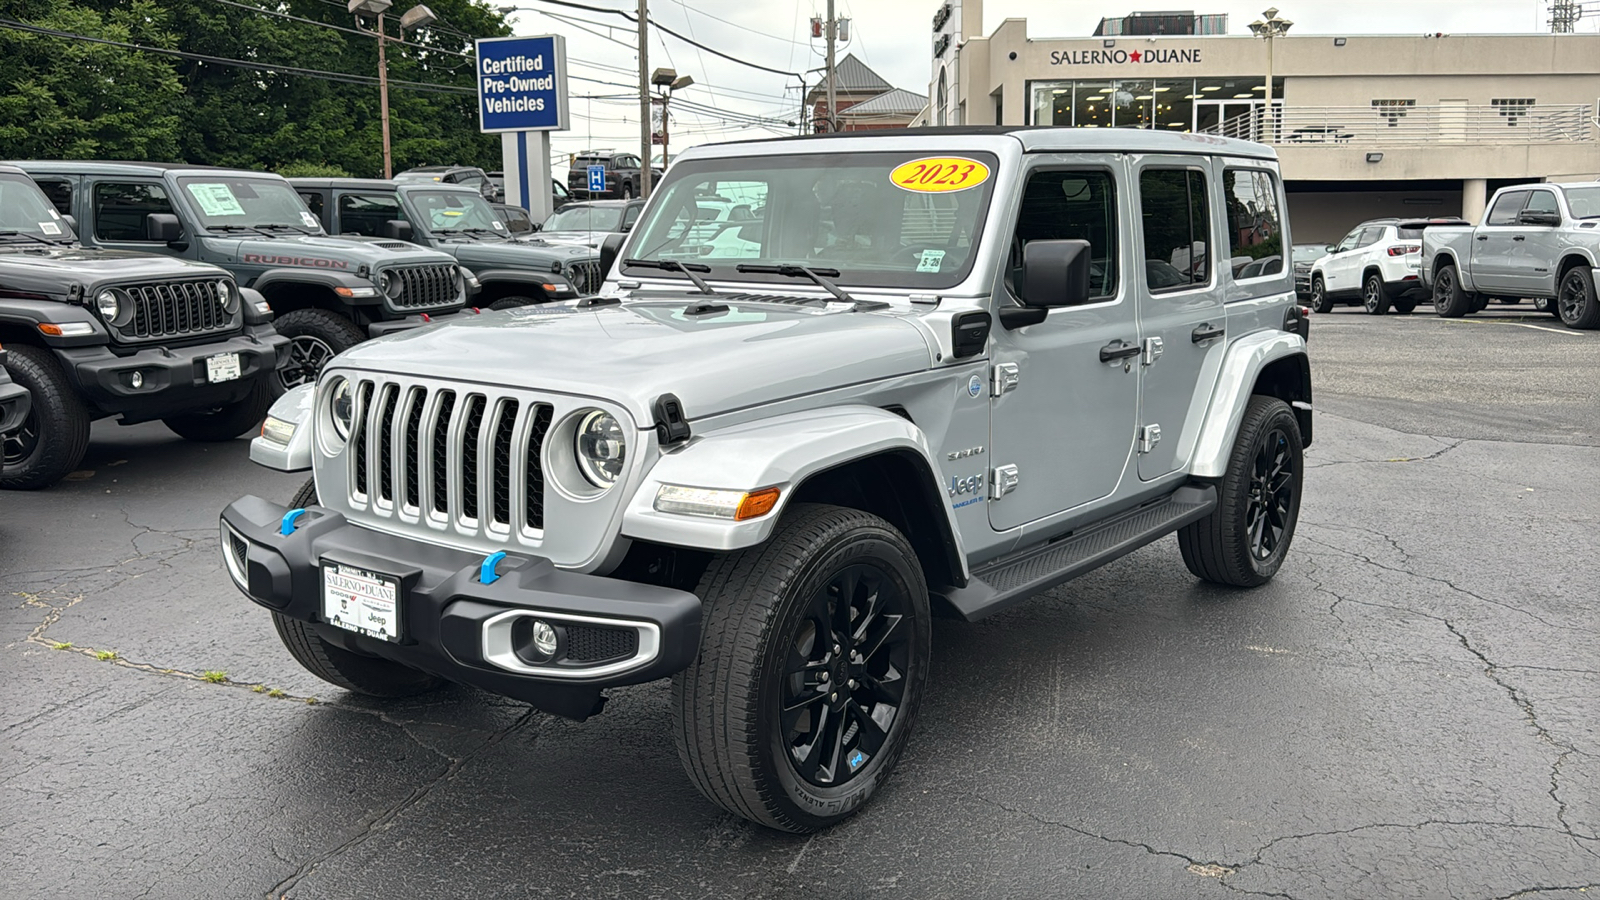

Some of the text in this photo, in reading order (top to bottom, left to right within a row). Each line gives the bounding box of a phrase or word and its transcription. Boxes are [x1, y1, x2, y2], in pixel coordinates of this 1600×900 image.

[482, 54, 543, 74] Certified
[1050, 49, 1201, 65] SALERNO DUANE
[483, 74, 553, 94] Pre-Owned
[485, 96, 545, 114] Vehicles
[591, 171, 602, 184] H
[901, 164, 976, 185] 2023
[244, 253, 349, 269] RUBICON
[922, 257, 929, 267] 5
[947, 446, 985, 461] SAHARA
[948, 473, 984, 498] Jeep
[326, 573, 395, 601] SALERNO DUANE
[368, 612, 387, 626] Jeep
[794, 784, 825, 808] ALENZA
